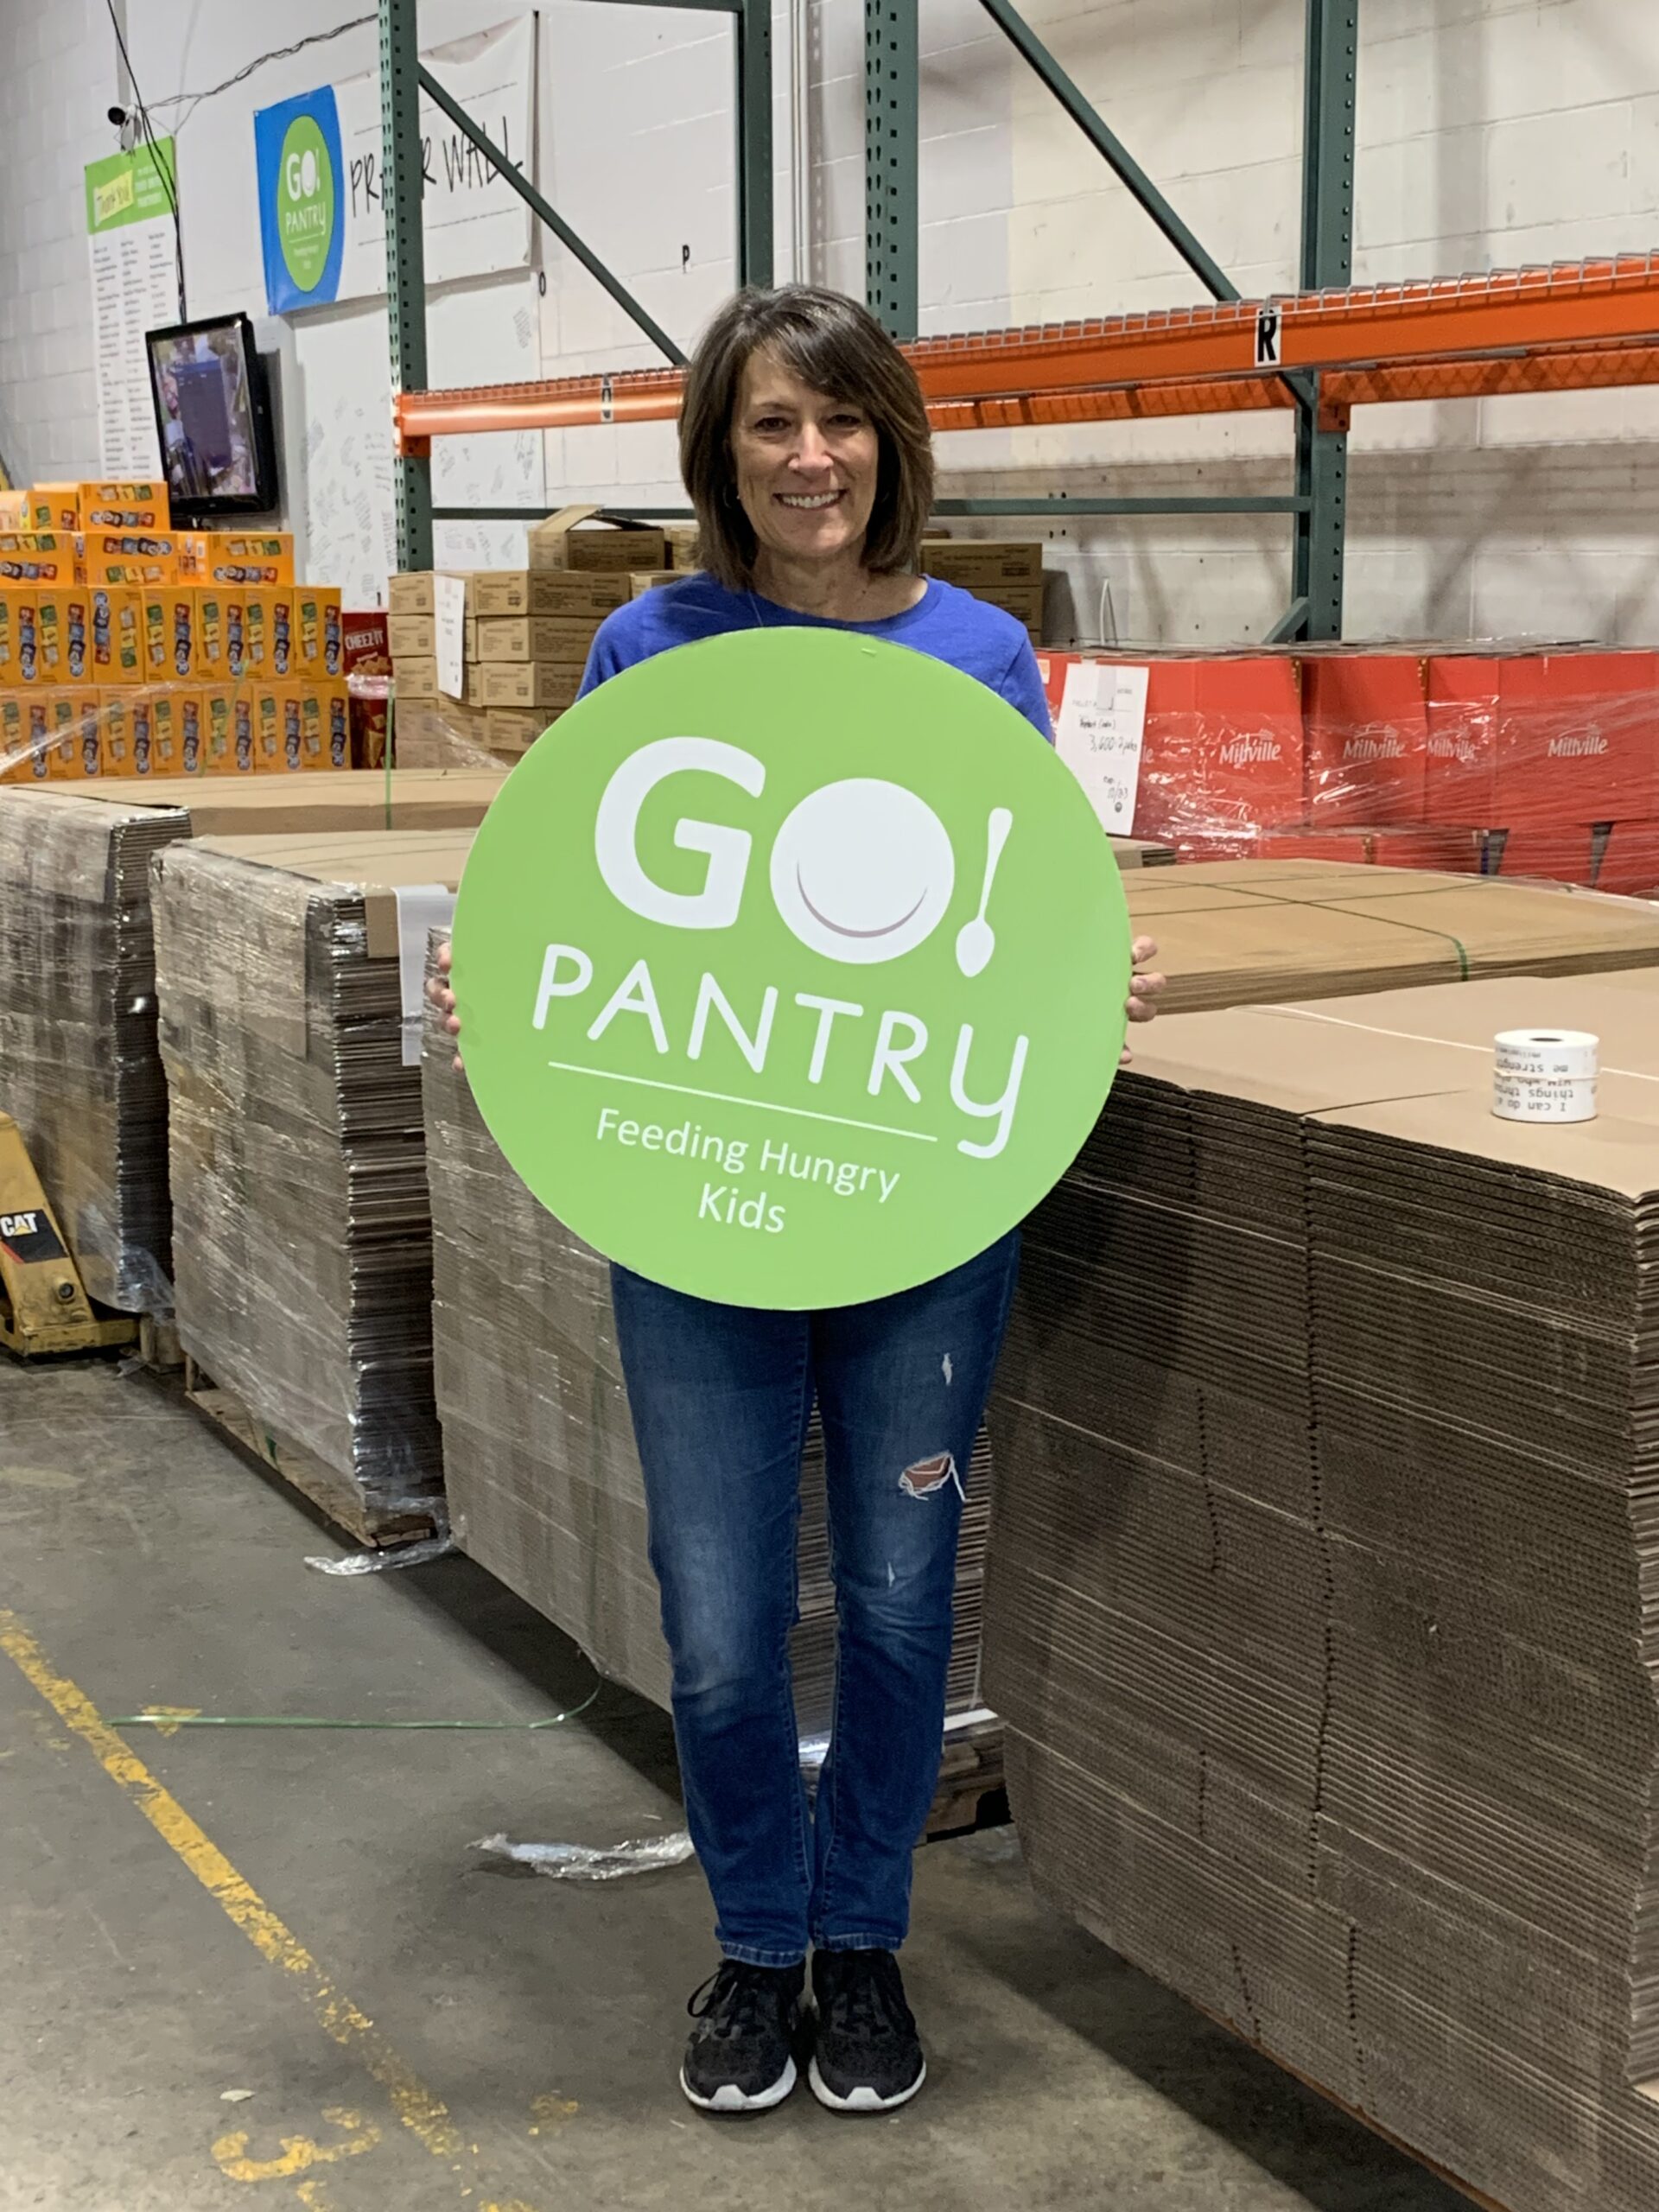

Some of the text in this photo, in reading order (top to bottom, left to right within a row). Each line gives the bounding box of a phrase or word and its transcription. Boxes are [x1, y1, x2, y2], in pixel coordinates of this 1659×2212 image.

[1258, 309, 1276, 361] R
[1548, 735, 1608, 757] Millville
[594, 736, 1014, 978] GO!
[1507, 1099, 1522, 1110] do
[1528, 1088, 1573, 1100] things
[1528, 1102, 1553, 1111] can
[1560, 1102, 1567, 1112] I
[597, 1108, 900, 1204] Feeding Hungry
[698, 1183, 785, 1233] Kids
[0, 1212, 38, 1236] CAT
